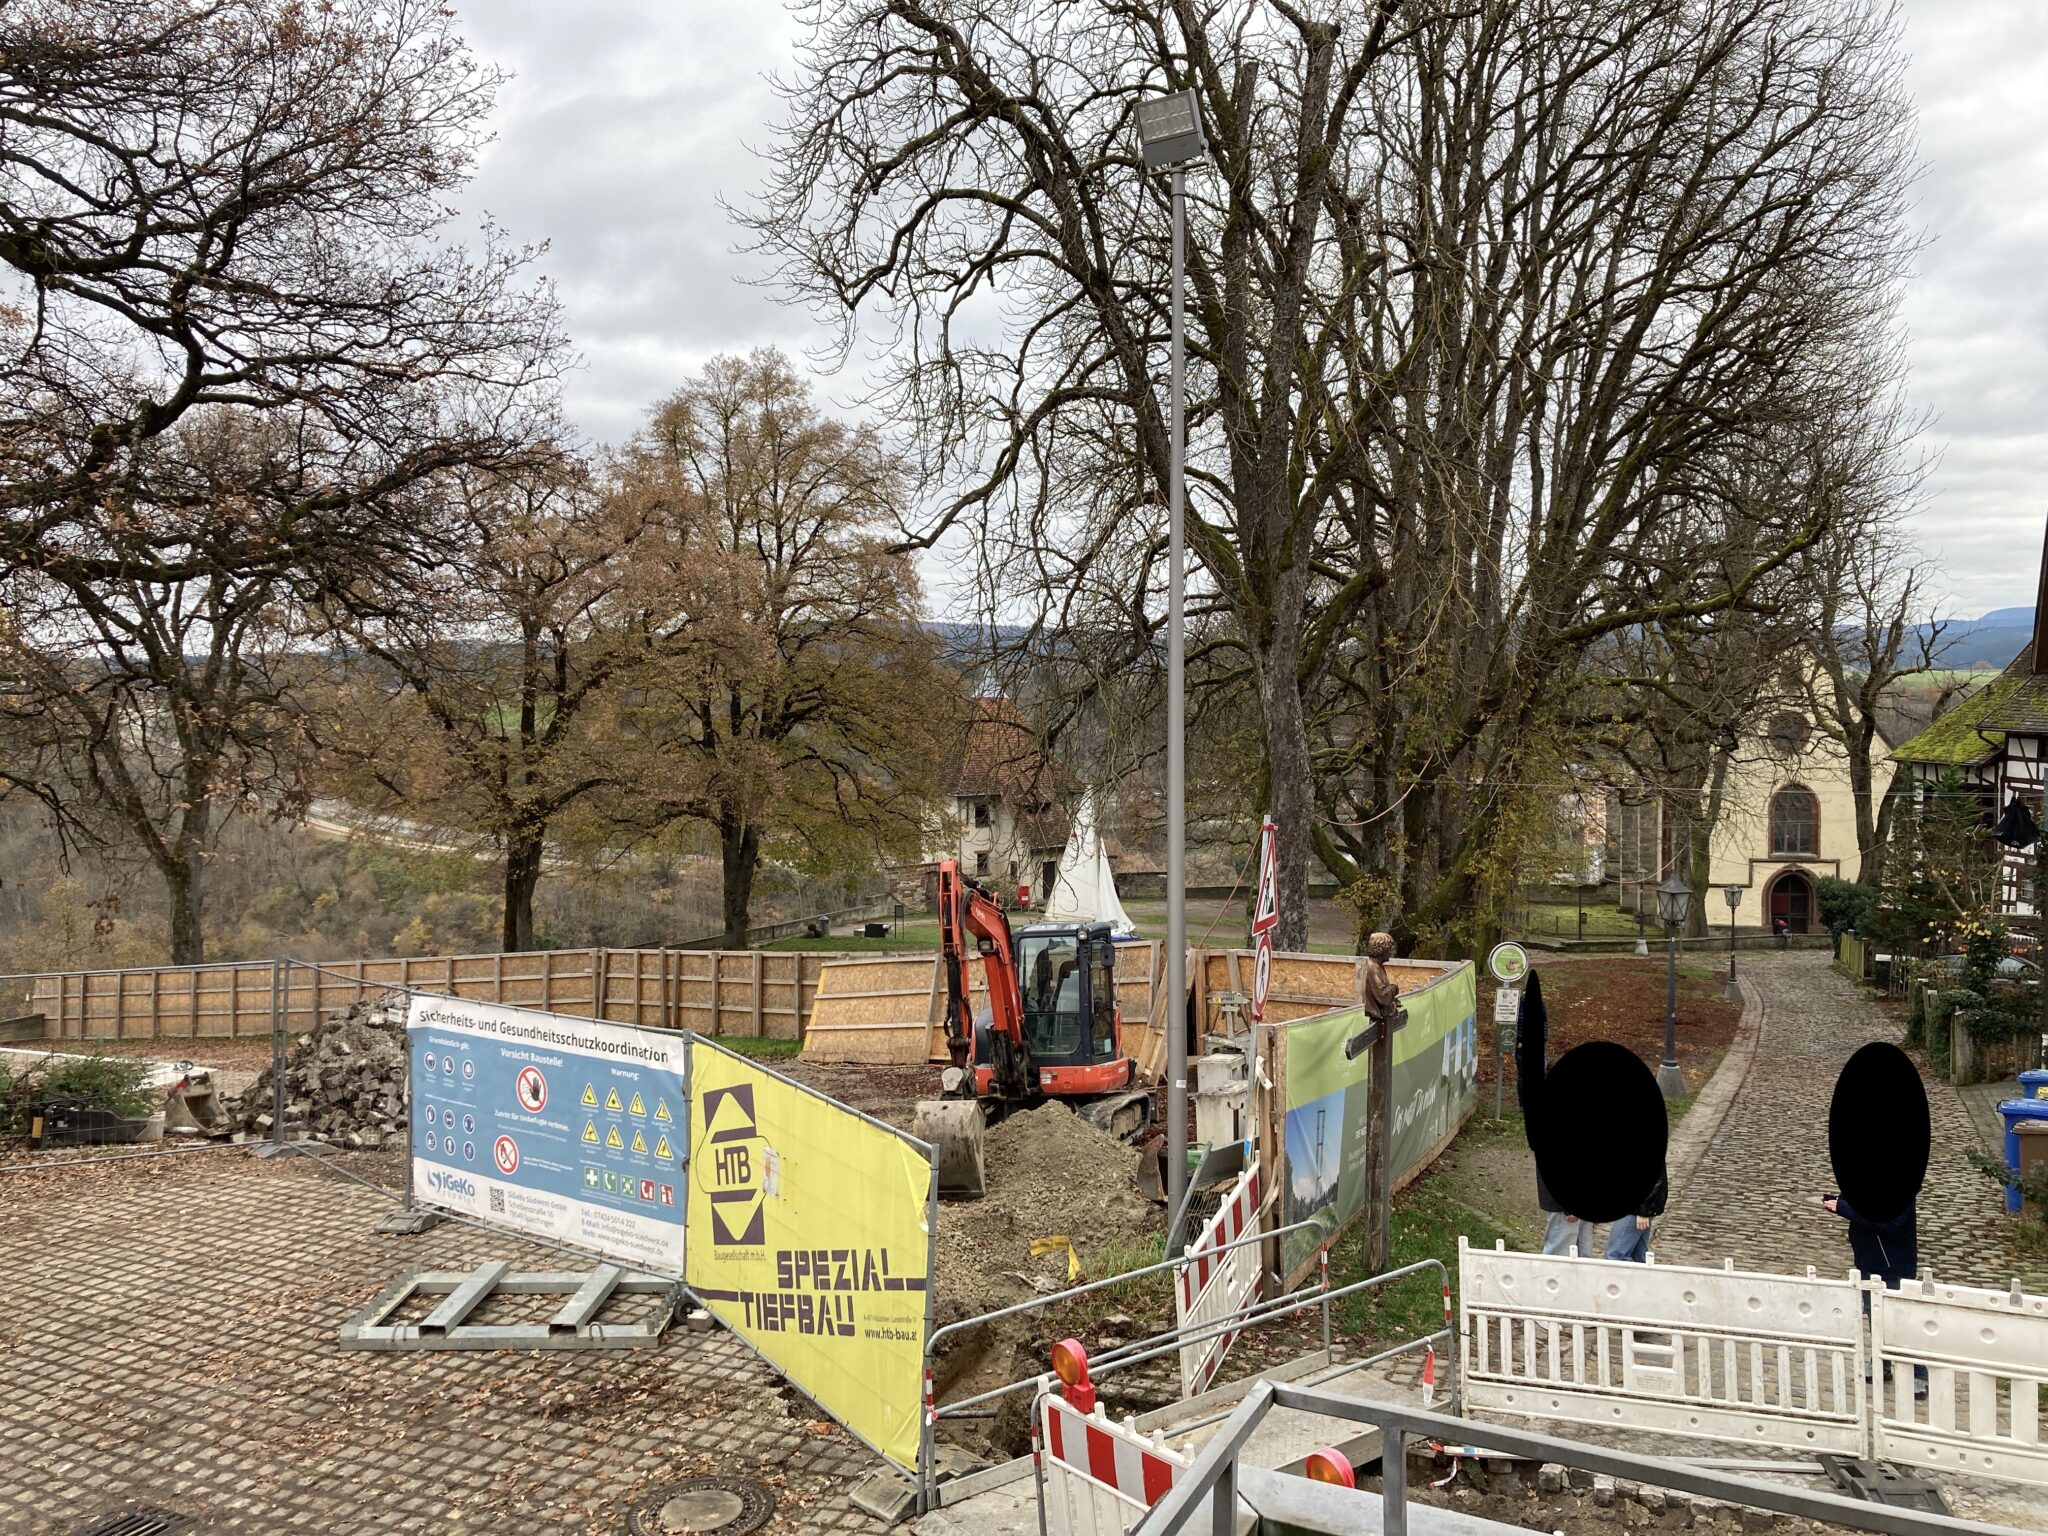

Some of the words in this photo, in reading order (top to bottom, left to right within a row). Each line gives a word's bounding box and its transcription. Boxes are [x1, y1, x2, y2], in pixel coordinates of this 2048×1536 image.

[420, 1009, 477, 1028] Sicherheits-
[478, 1018, 497, 1032] und
[500, 1021, 669, 1063] Gesundheitsschutzkoordination
[500, 1047, 530, 1061] Vorsicht
[610, 1067, 640, 1081] Warnung:
[715, 1145, 752, 1186] HTB
[777, 1248, 905, 1291] SPEZIAL
[738, 1290, 856, 1337] TIEFBAU
